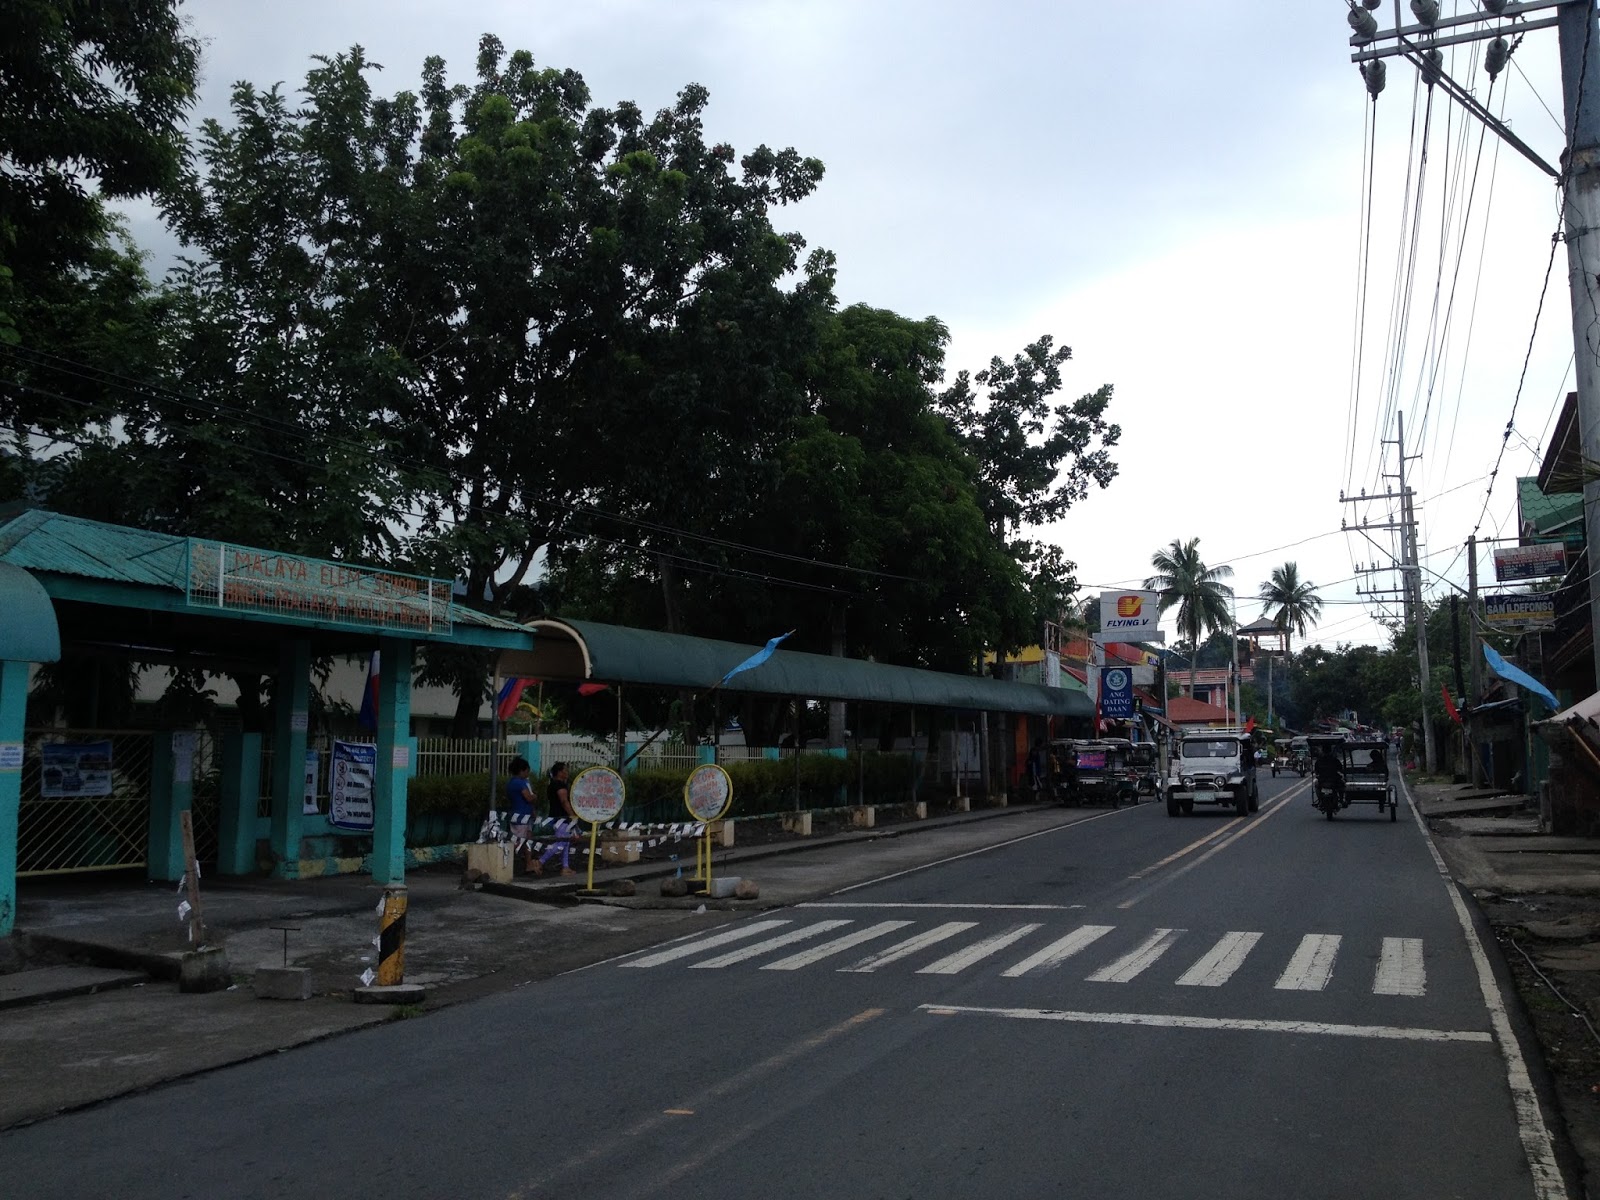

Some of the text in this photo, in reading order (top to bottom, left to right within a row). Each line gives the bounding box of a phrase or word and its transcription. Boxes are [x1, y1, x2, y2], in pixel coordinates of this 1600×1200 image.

[235, 551, 307, 580] MALAYA
[1487, 602, 1554, 614] SAN ILDEFONSO
[1107, 619, 1139, 627] FLYING
